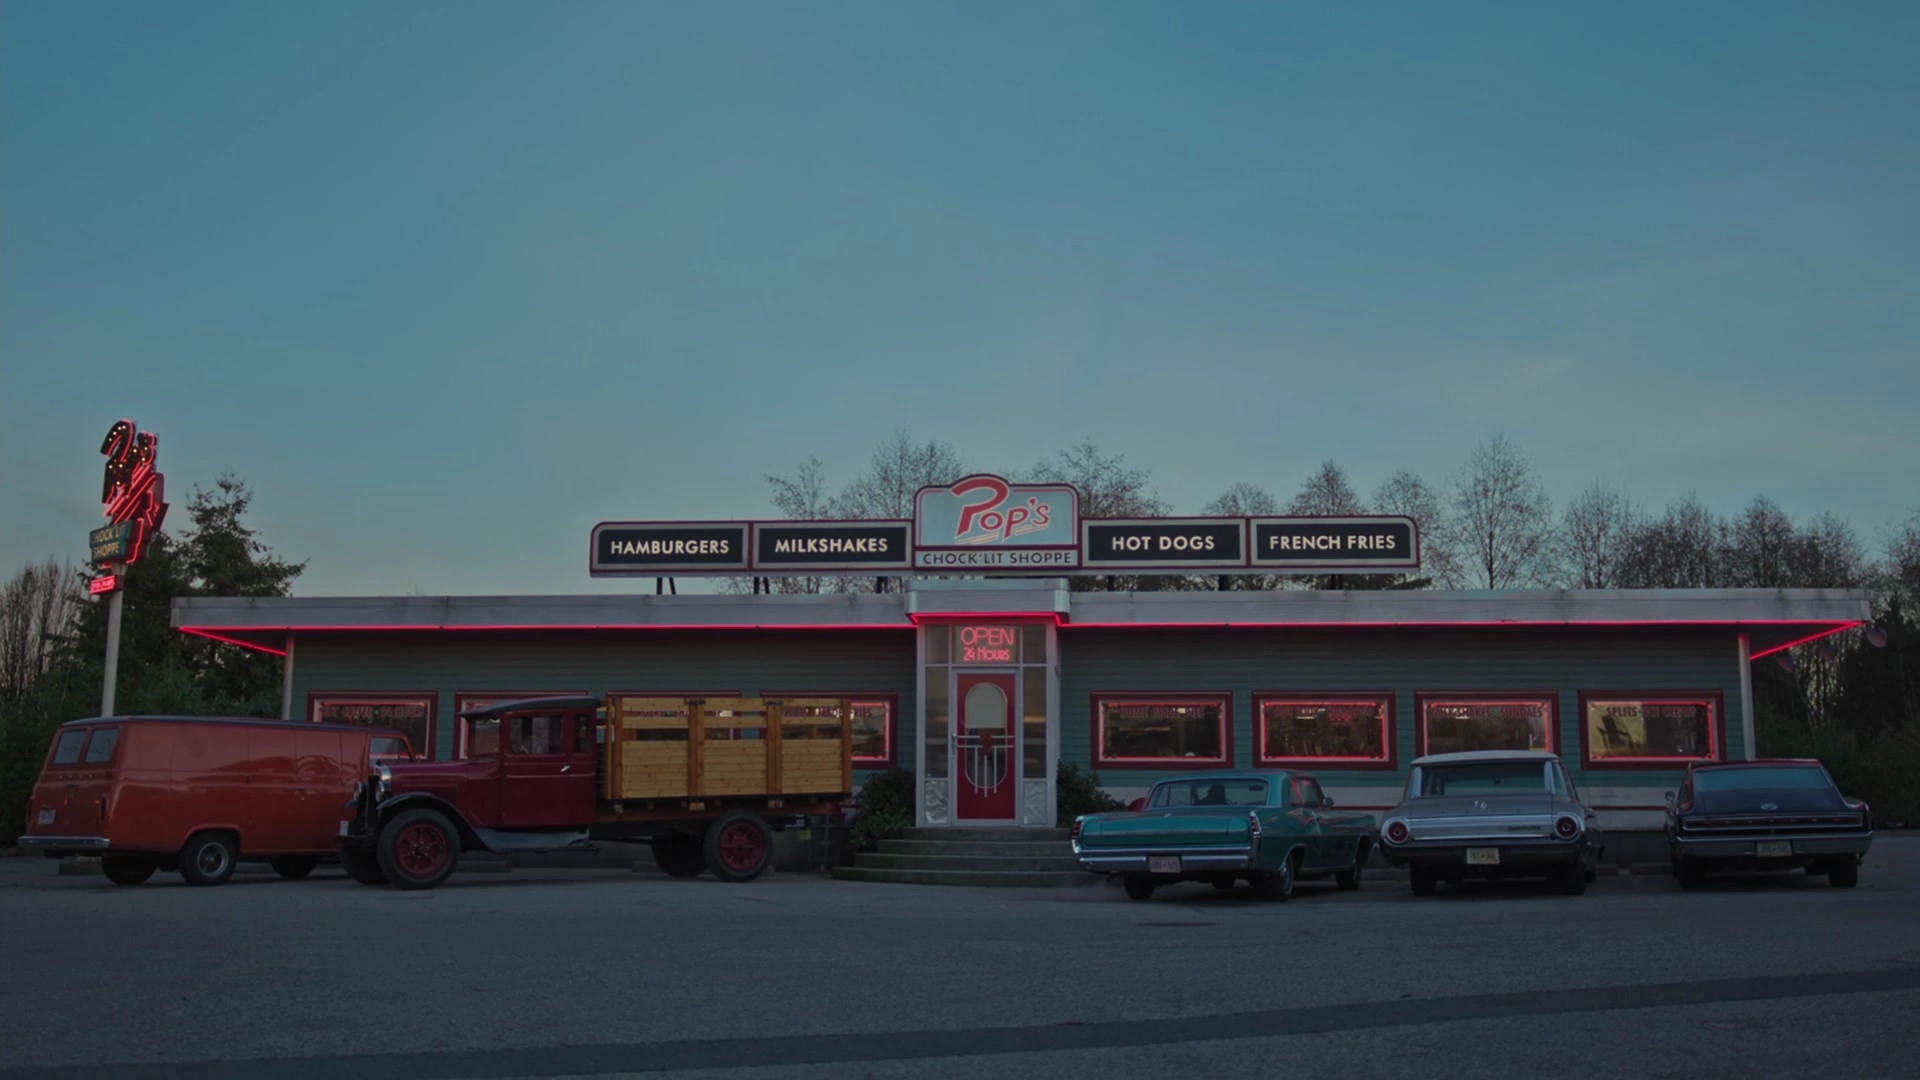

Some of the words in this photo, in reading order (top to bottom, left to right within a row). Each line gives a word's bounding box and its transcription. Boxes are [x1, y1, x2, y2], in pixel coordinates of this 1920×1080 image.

[610, 539, 730, 556] HAMBURGERS
[774, 536, 889, 554] MILKSHAKES
[1111, 535, 1152, 551] HOT
[1158, 535, 1216, 551] DOGS
[1269, 534, 1342, 550] FRENCH
[1347, 534, 1397, 550] FRIES
[1010, 552, 1072, 564] SHOPPE
[960, 626, 1015, 646] OPEN
[963, 646, 976, 662] 24
[1500, 706, 1543, 717] SUNDAES
[1606, 706, 1637, 717] SPLITS
